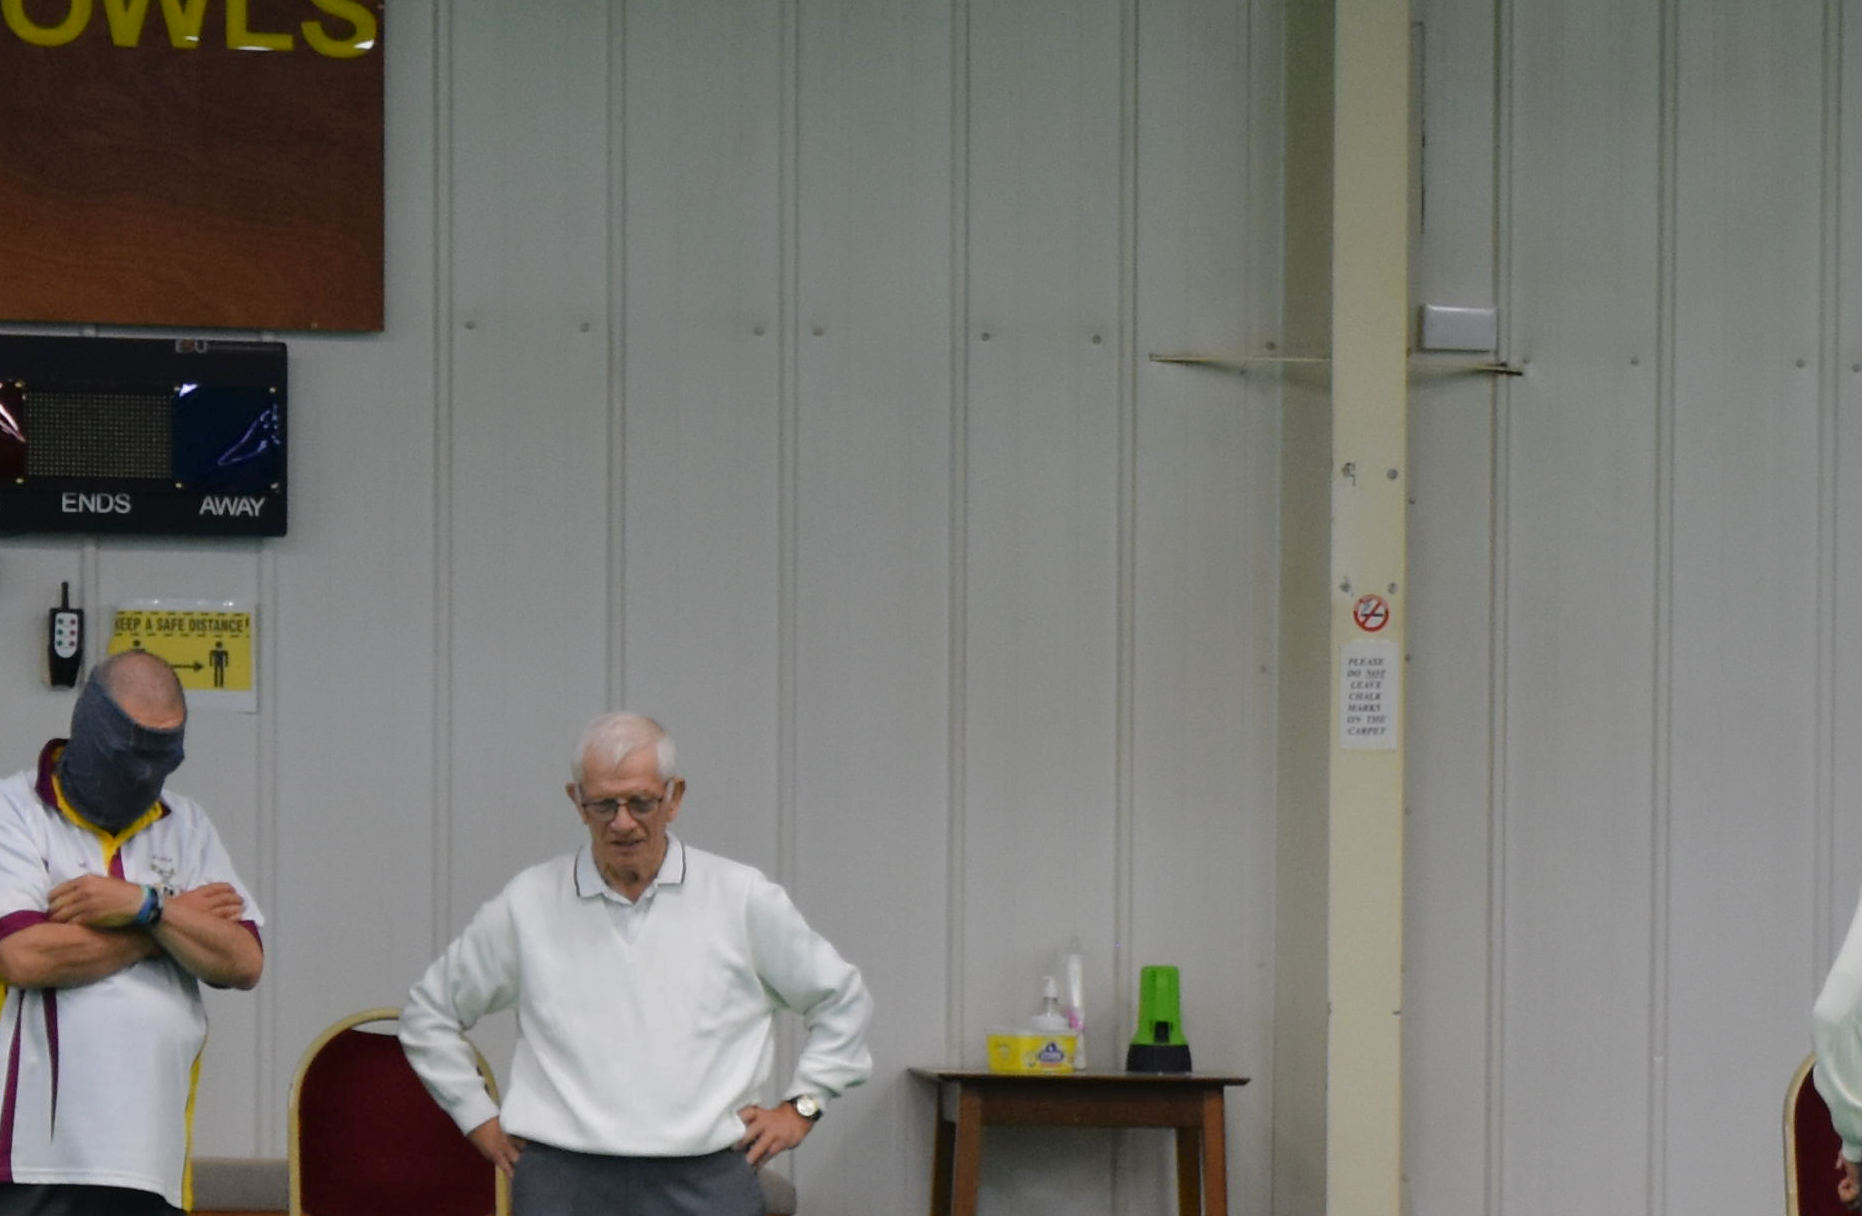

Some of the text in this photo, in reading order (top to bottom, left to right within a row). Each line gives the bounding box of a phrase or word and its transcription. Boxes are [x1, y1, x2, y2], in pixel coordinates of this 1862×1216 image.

[61, 492, 265, 517] ENDS AWAY
[145, 616, 153, 632] A
[156, 617, 185, 632] SAFE
[1348, 657, 1384, 667] PLEASE
[1347, 669, 1386, 679] DO NOT
[1350, 680, 1382, 690] LEAVE
[1348, 692, 1381, 701] CHALK
[1348, 703, 1381, 712] MARKS
[1347, 715, 1386, 724] ON THE
[1347, 726, 1386, 736] CARPET
